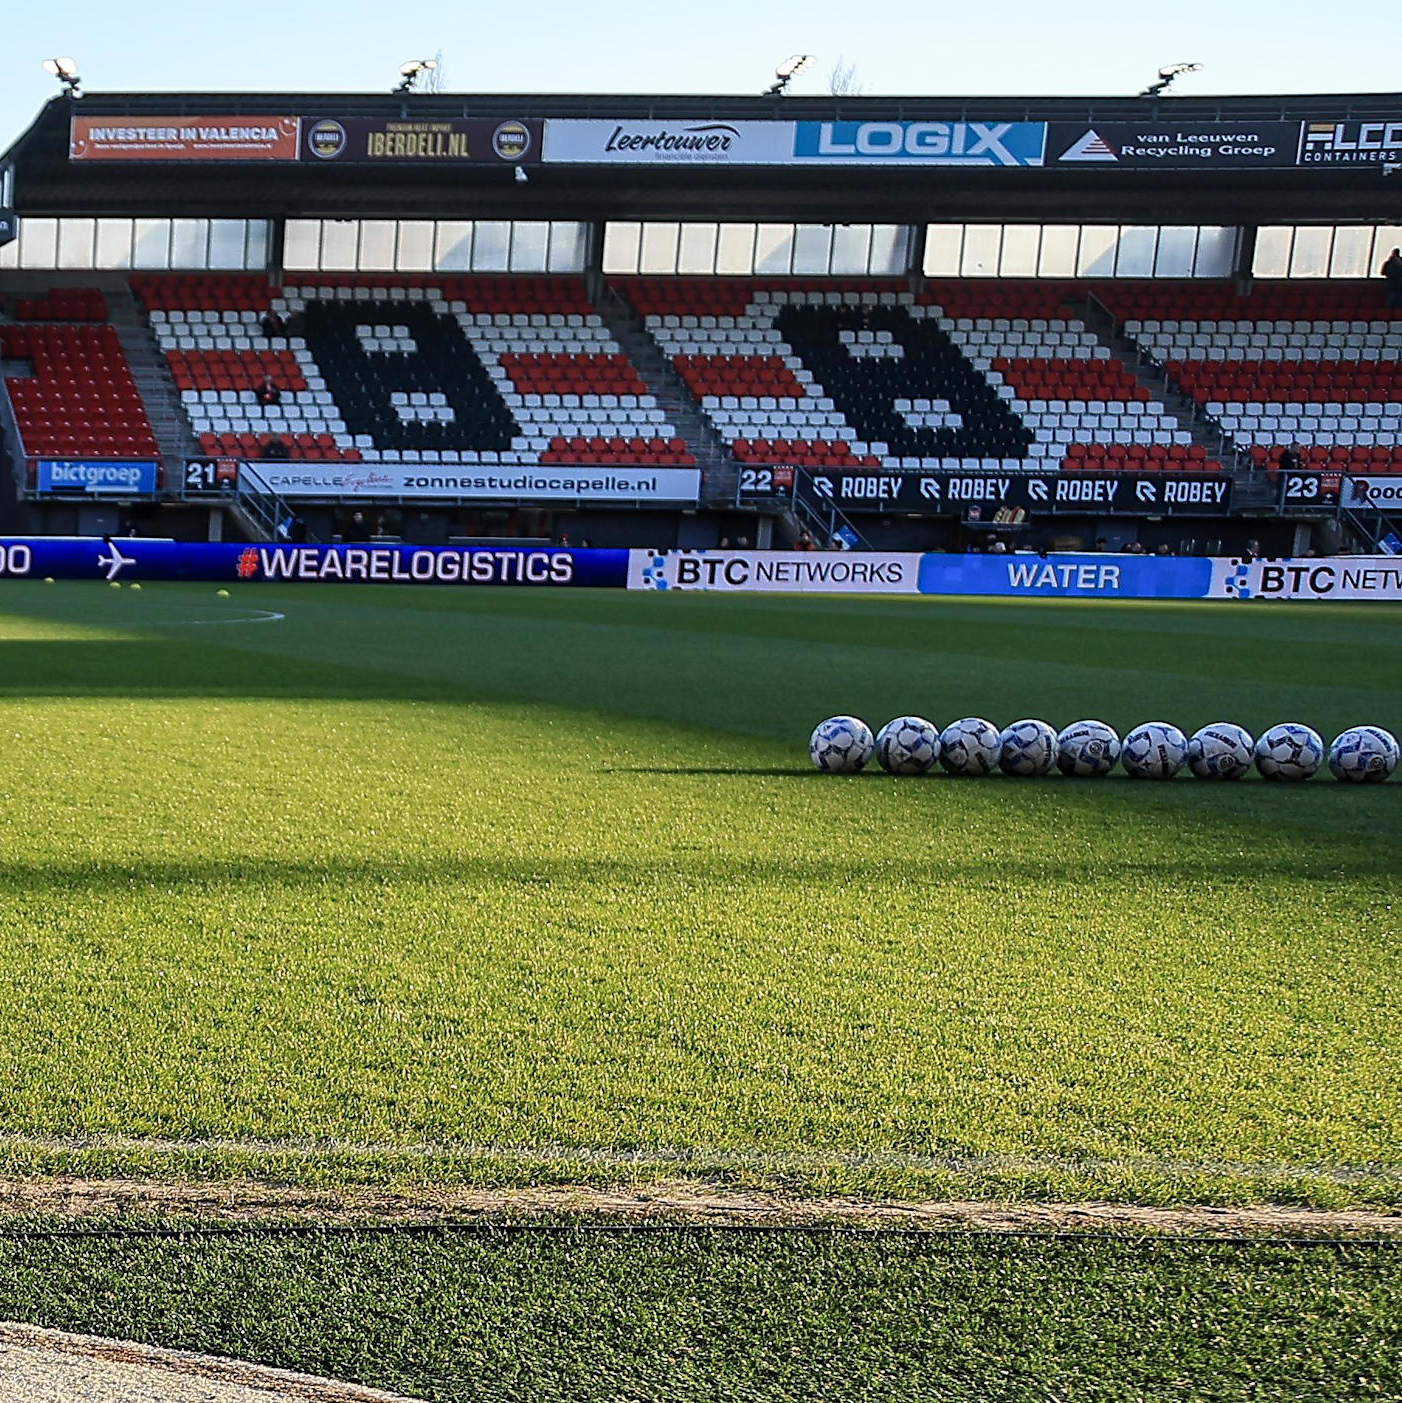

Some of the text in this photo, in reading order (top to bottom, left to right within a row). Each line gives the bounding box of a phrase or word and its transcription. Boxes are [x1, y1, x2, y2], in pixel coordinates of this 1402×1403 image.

[89, 128, 279, 141] INVESTEER IN VALENCIA
[367, 132, 469, 156] IBERDELI.NL
[605, 125, 732, 152] Leertouwer
[819, 122, 1020, 165] LOGIX
[1137, 132, 1258, 143] van Leeuwen
[1121, 145, 1276, 157] Recycling Groep
[1304, 152, 1396, 161] CONTAINERS
[51, 462, 141, 484] bictgroep
[187, 463, 214, 483] 21
[269, 476, 343, 486] CAPELLE
[742, 470, 772, 490] 22
[403, 475, 657, 494] zonnestudiocapelle.nl
[841, 476, 903, 498] ROBEY
[948, 478, 1010, 500] ROBEY
[1056, 480, 1118, 501] ROBEY
[1164, 481, 1226, 503] ROBEY
[1287, 477, 1318, 498] 23
[237, 548, 573, 582] #WEARELOGISTICS
[677, 558, 903, 585] BTC NETWORKS
[1008, 564, 1120, 589] WATER
[1260, 566, 1335, 593] BTC
